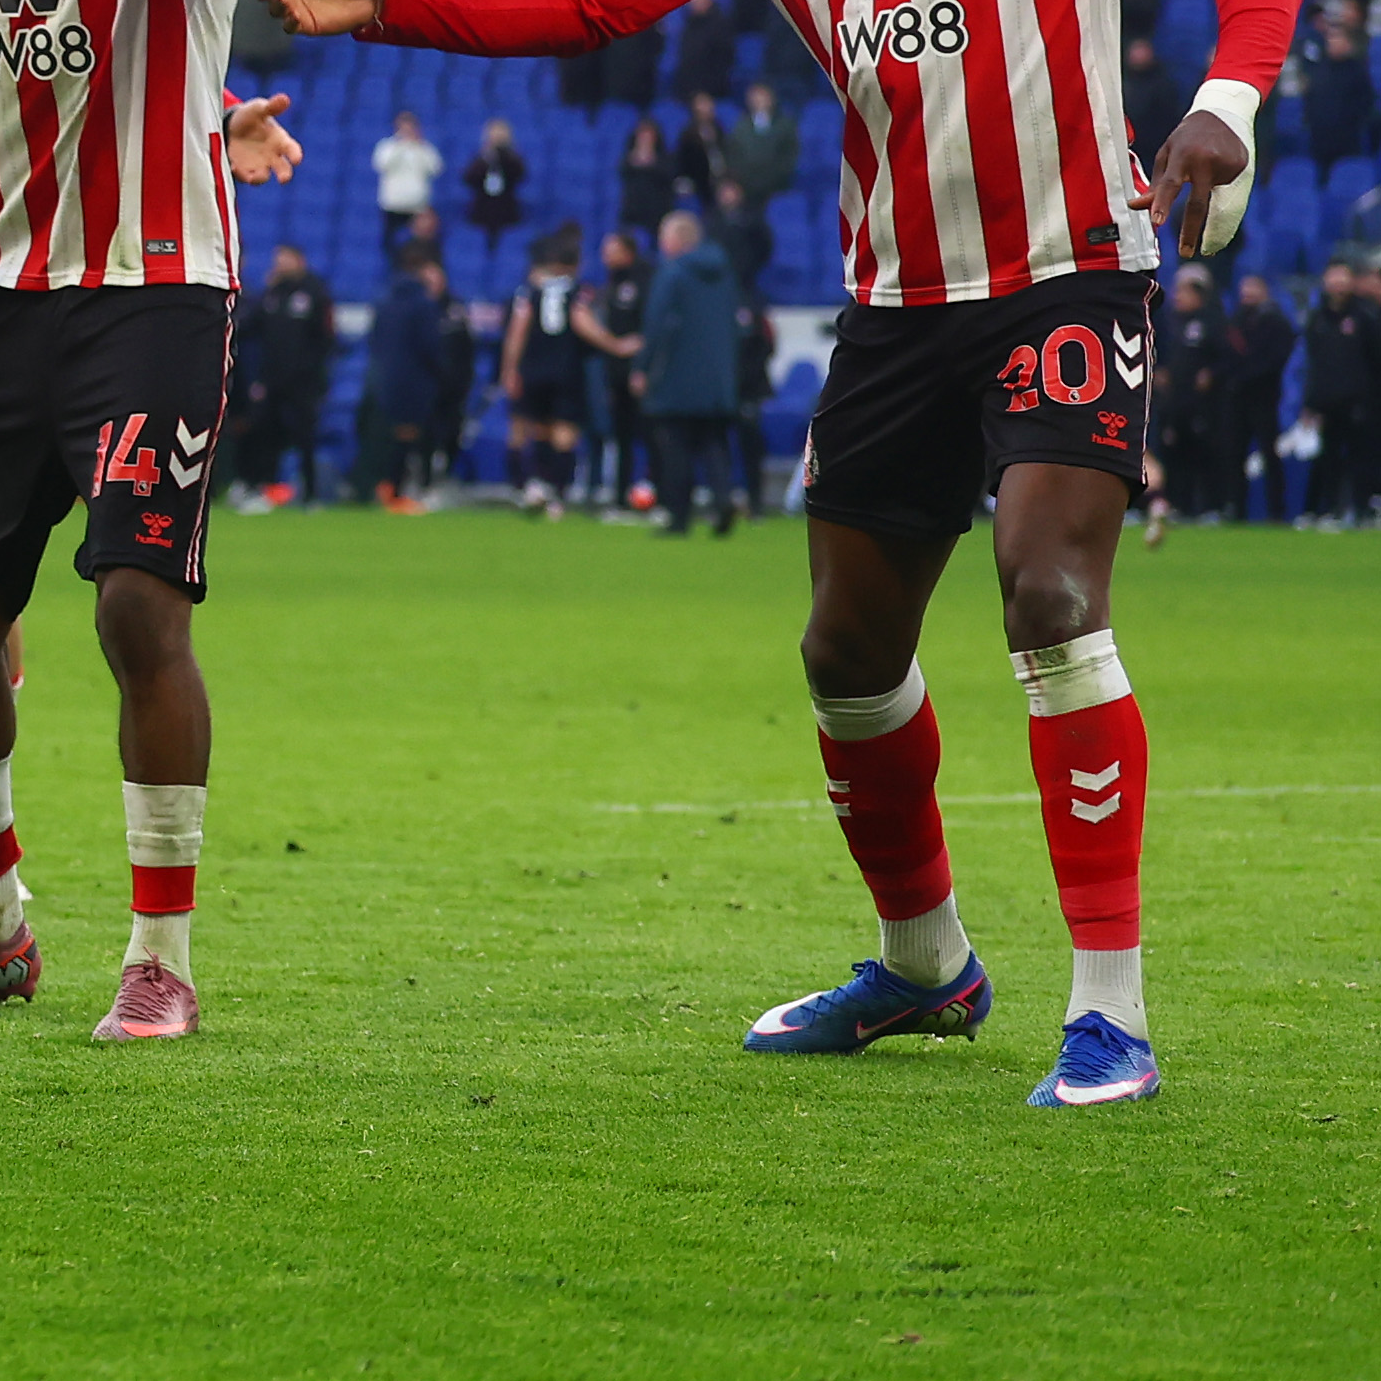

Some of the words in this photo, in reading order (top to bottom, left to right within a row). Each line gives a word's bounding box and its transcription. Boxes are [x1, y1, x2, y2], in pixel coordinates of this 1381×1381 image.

[840, 1, 966, 66] W88
[996, 323, 1107, 413] 20
[91, 412, 161, 500] 14
